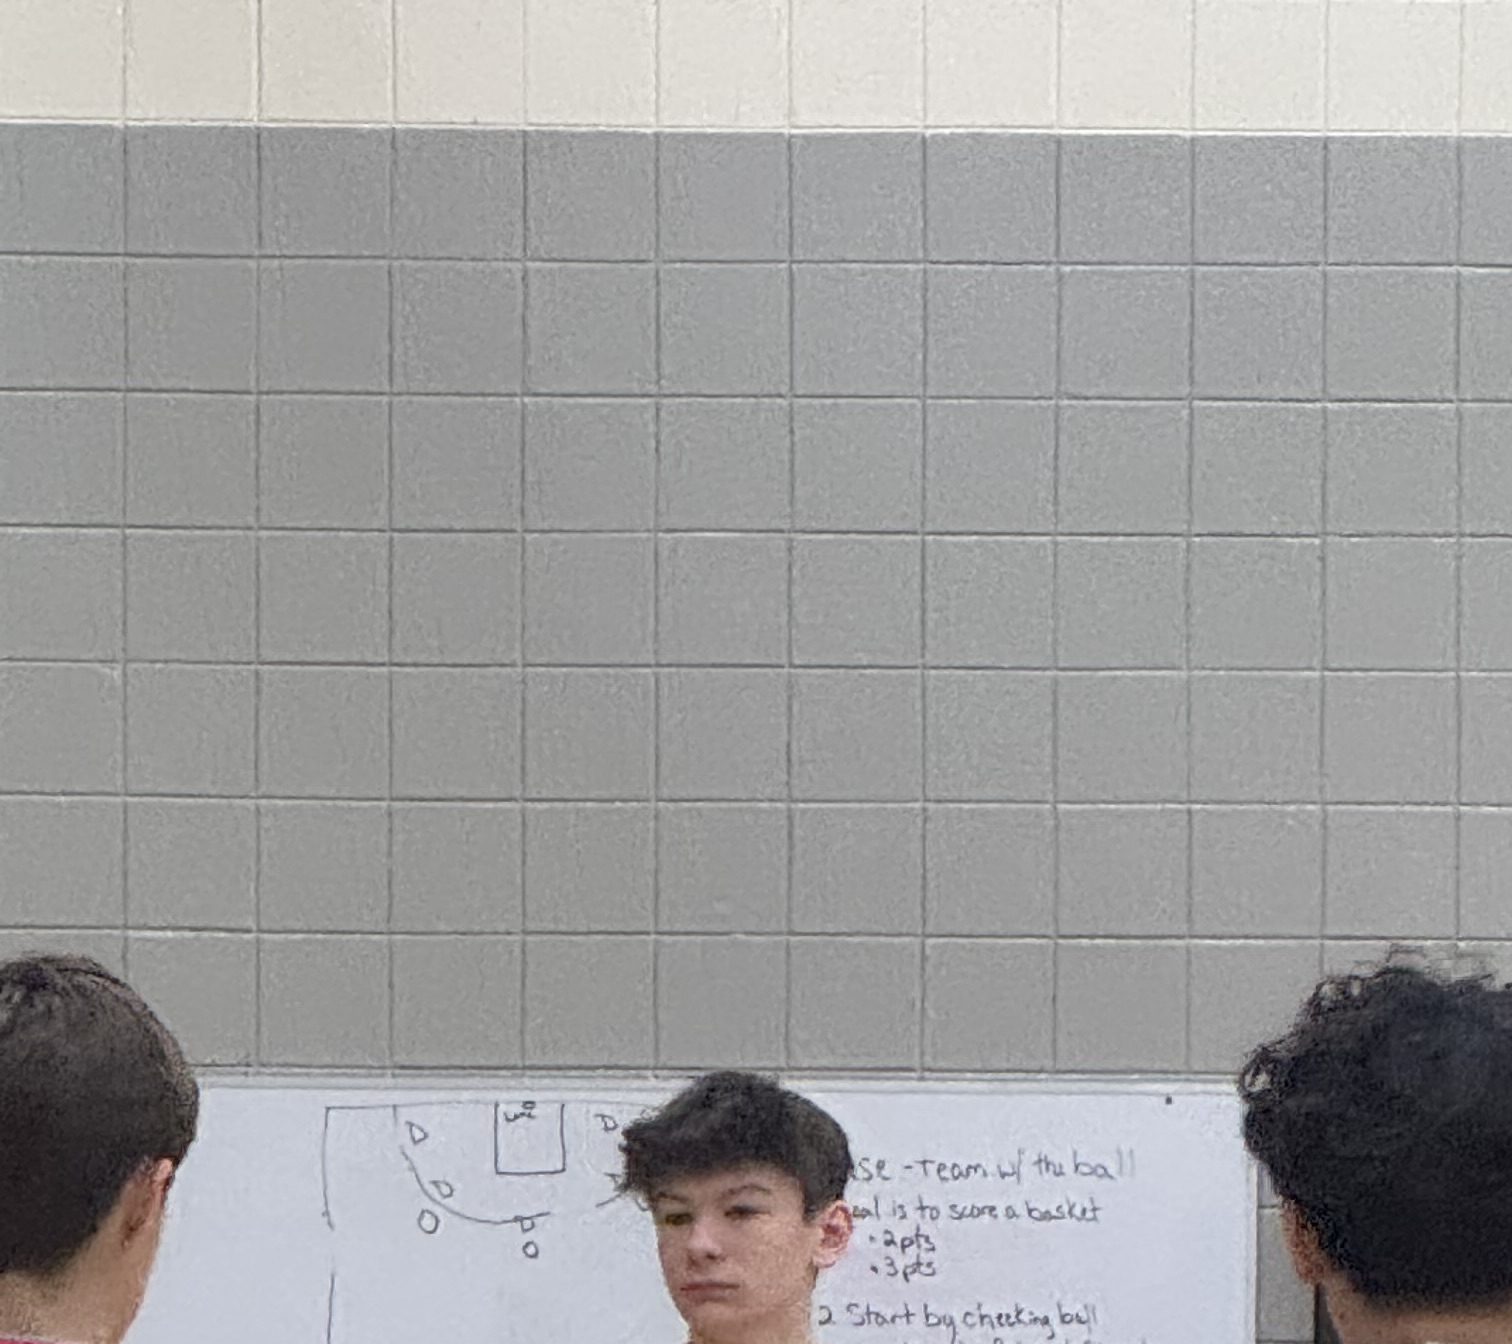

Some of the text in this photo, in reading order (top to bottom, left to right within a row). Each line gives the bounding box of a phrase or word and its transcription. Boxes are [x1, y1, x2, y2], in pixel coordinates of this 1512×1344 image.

[1072, 1146, 1135, 1180] ball
[916, 1194, 940, 1220] to
[949, 1203, 998, 1221] score
[1005, 1205, 1020, 1220] a
[1025, 1195, 1102, 1222] basket
[846, 1302, 916, 1327] Start
[923, 1303, 958, 1344] by
